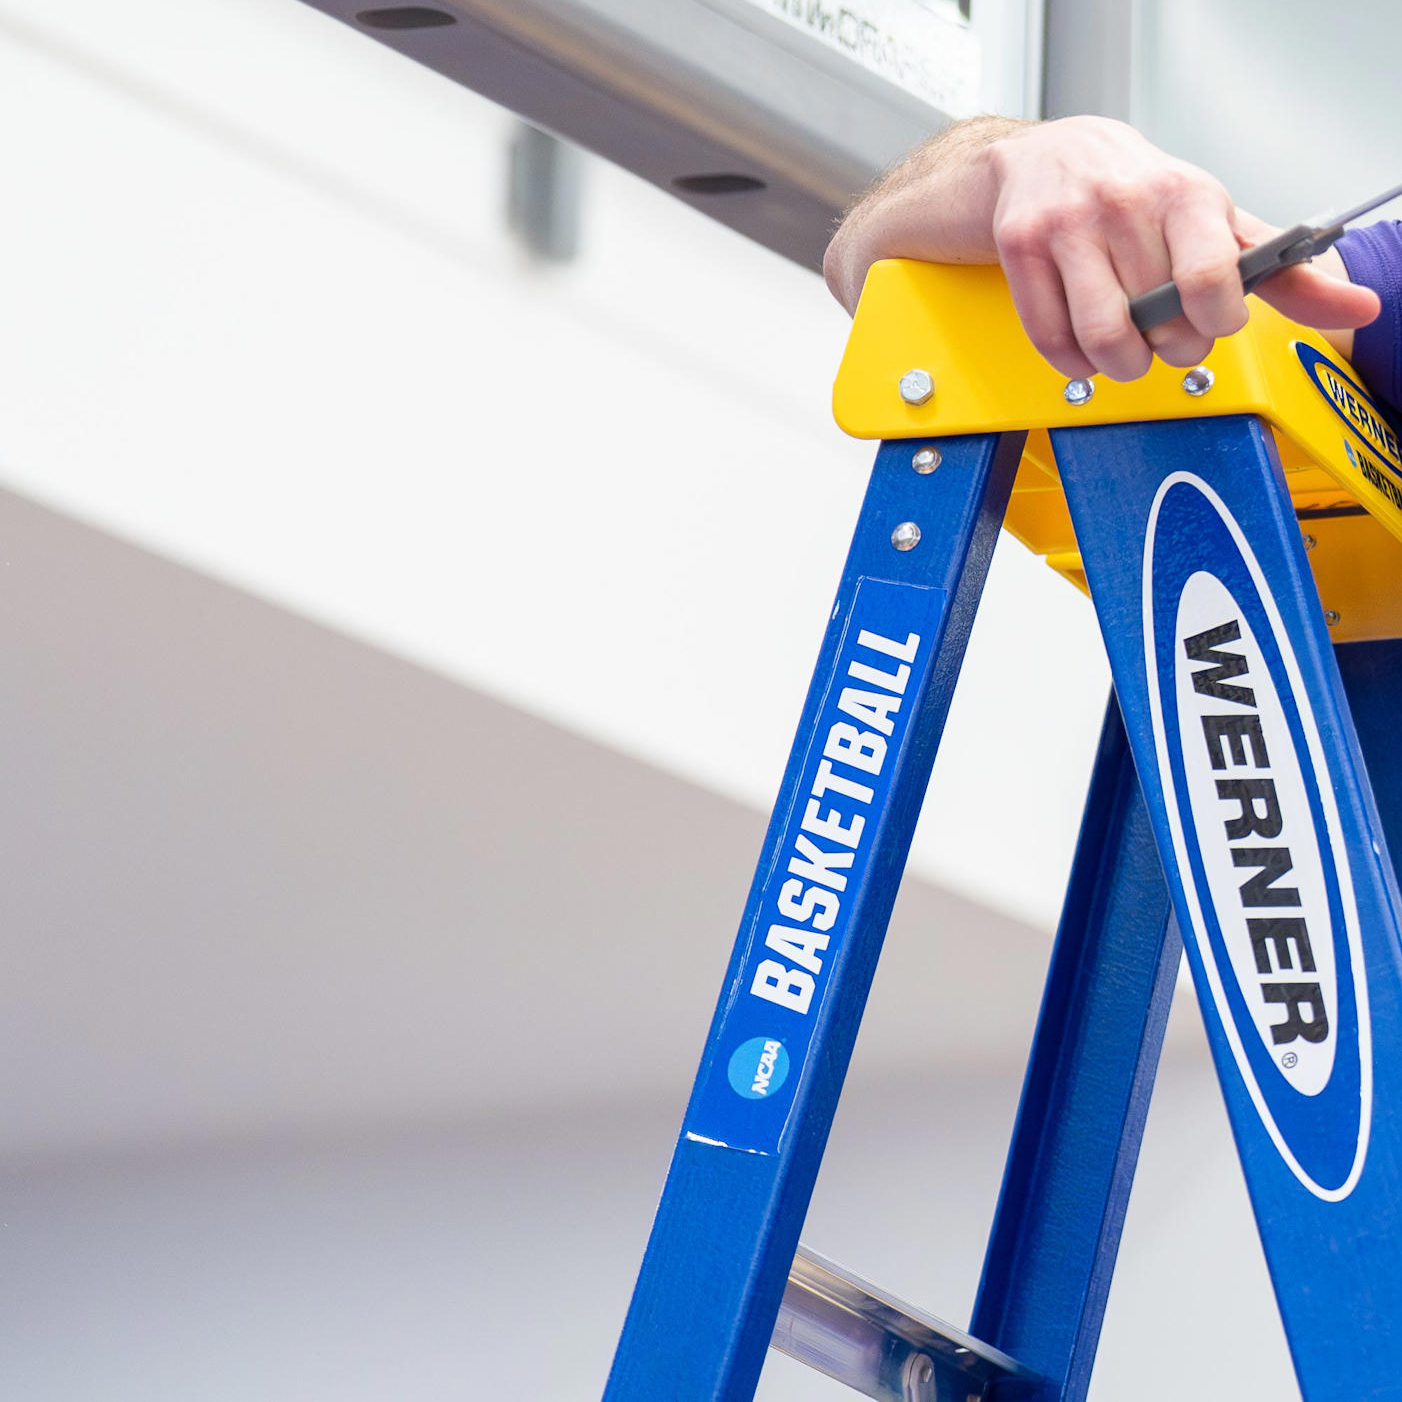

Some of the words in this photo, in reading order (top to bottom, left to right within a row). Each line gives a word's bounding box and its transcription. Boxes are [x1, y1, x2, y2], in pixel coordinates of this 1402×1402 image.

[749, 629, 921, 1015] BASKETBALL
[1183, 619, 1330, 1046] WERNER
[751, 1039, 782, 1096] NCAA
